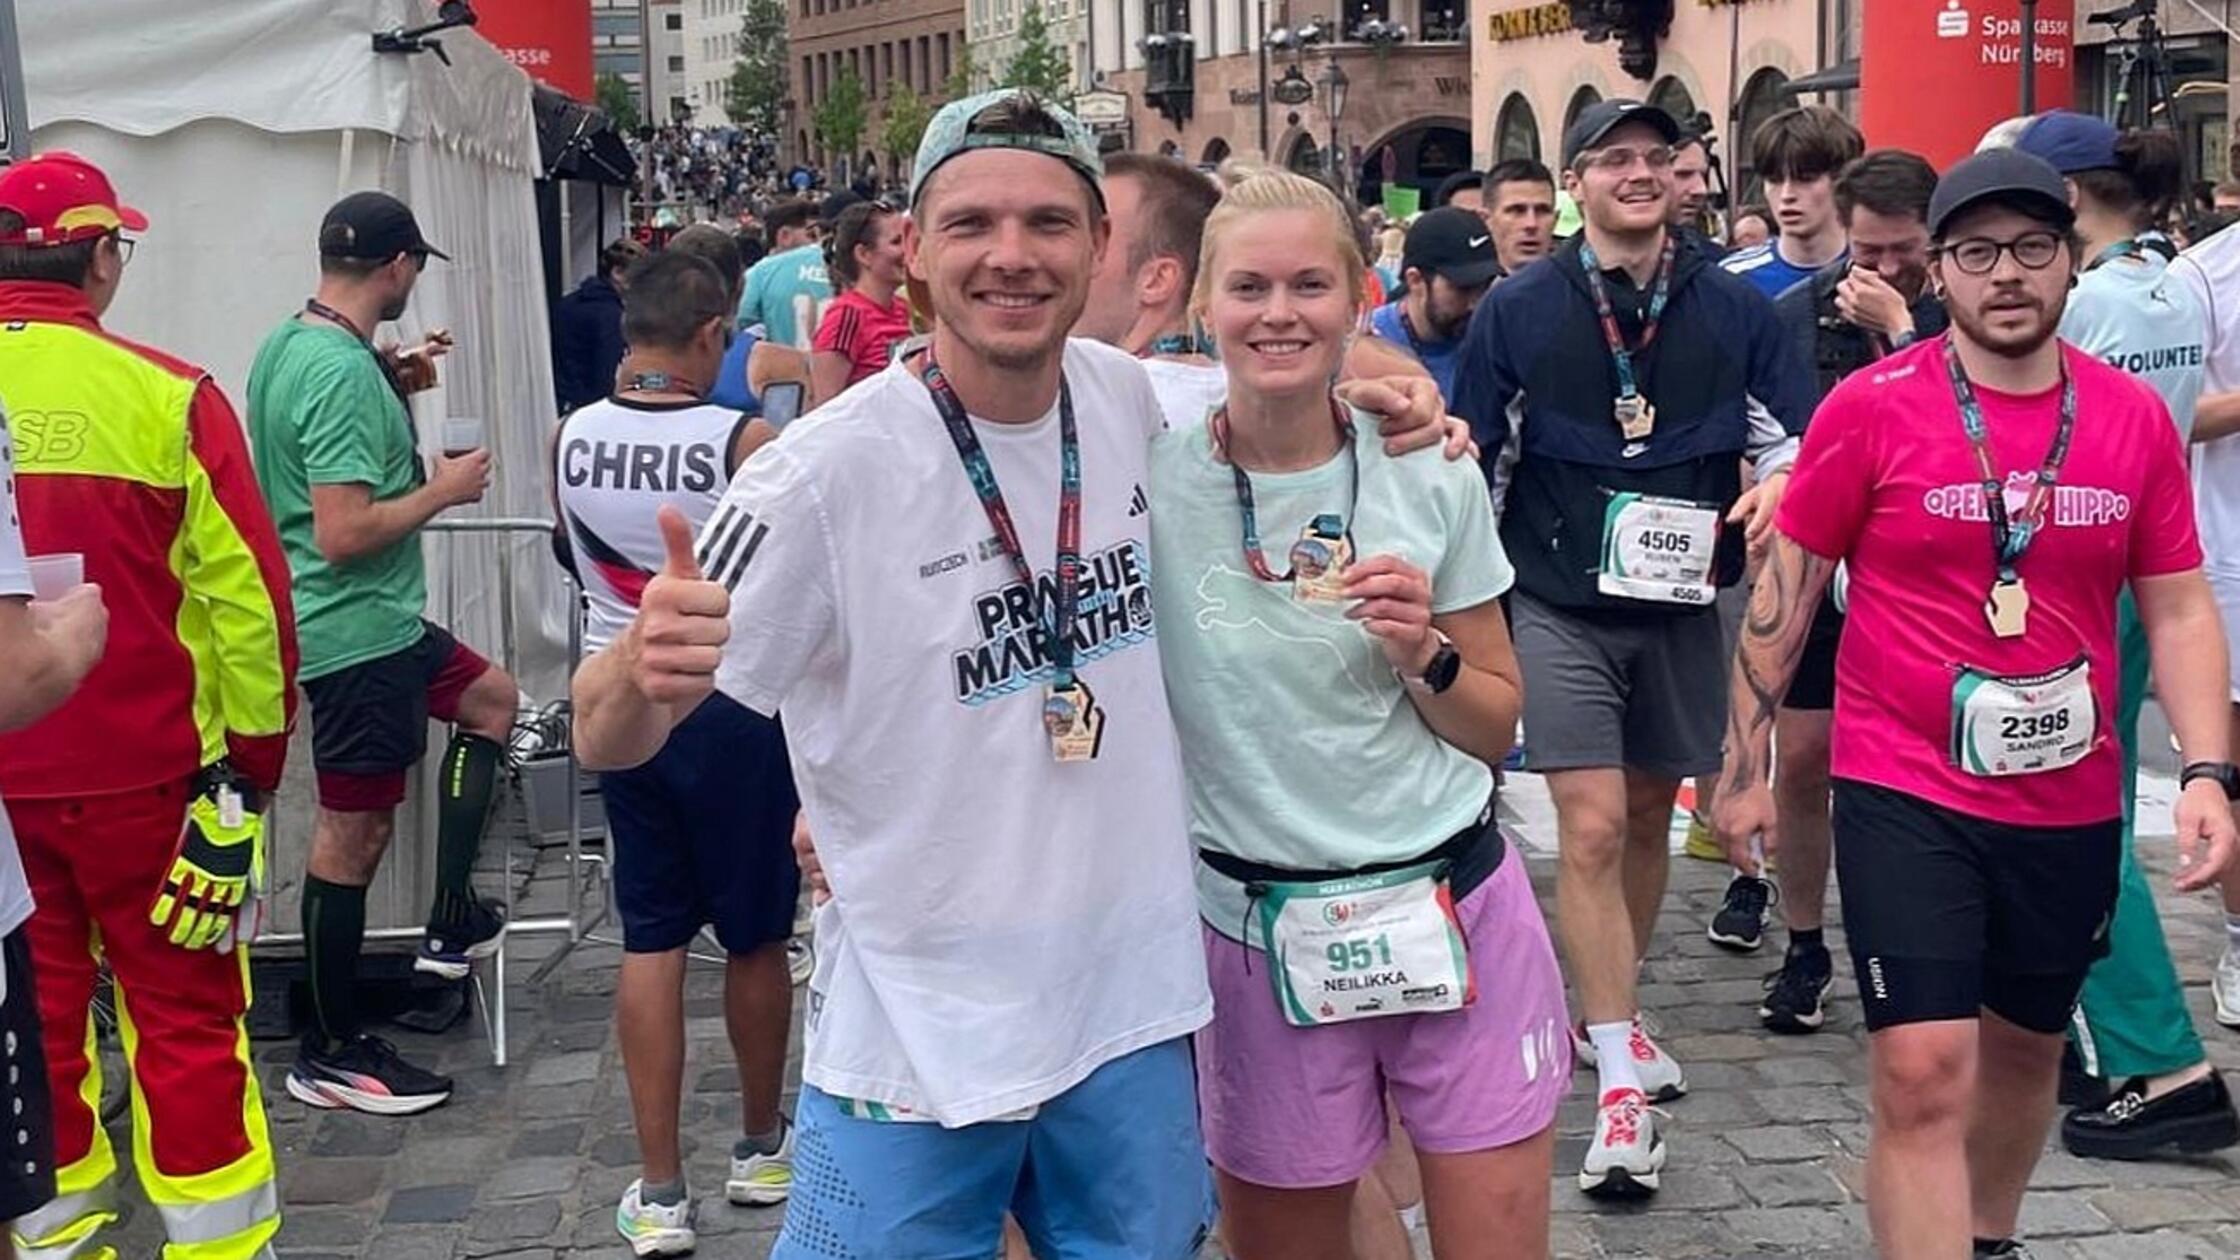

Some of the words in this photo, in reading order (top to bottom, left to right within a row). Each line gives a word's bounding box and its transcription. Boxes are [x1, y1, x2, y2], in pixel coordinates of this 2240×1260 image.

[1982, 43, 2066, 68] Nürberg
[2107, 344, 2202, 374] VOLUNTE
[564, 438, 717, 492] CHRIS
[2054, 486, 2130, 526] HIPPO
[1638, 530, 1692, 553] 4505
[975, 543, 1143, 640] PRAGUE
[1671, 586, 1703, 602] 4505
[2001, 707, 2071, 740] 2398
[2006, 735, 2066, 754] SANDRO
[1318, 877, 1384, 895] MARATHON
[1327, 933, 1392, 972] 951
[1323, 970, 1409, 992] NEILIKKA
